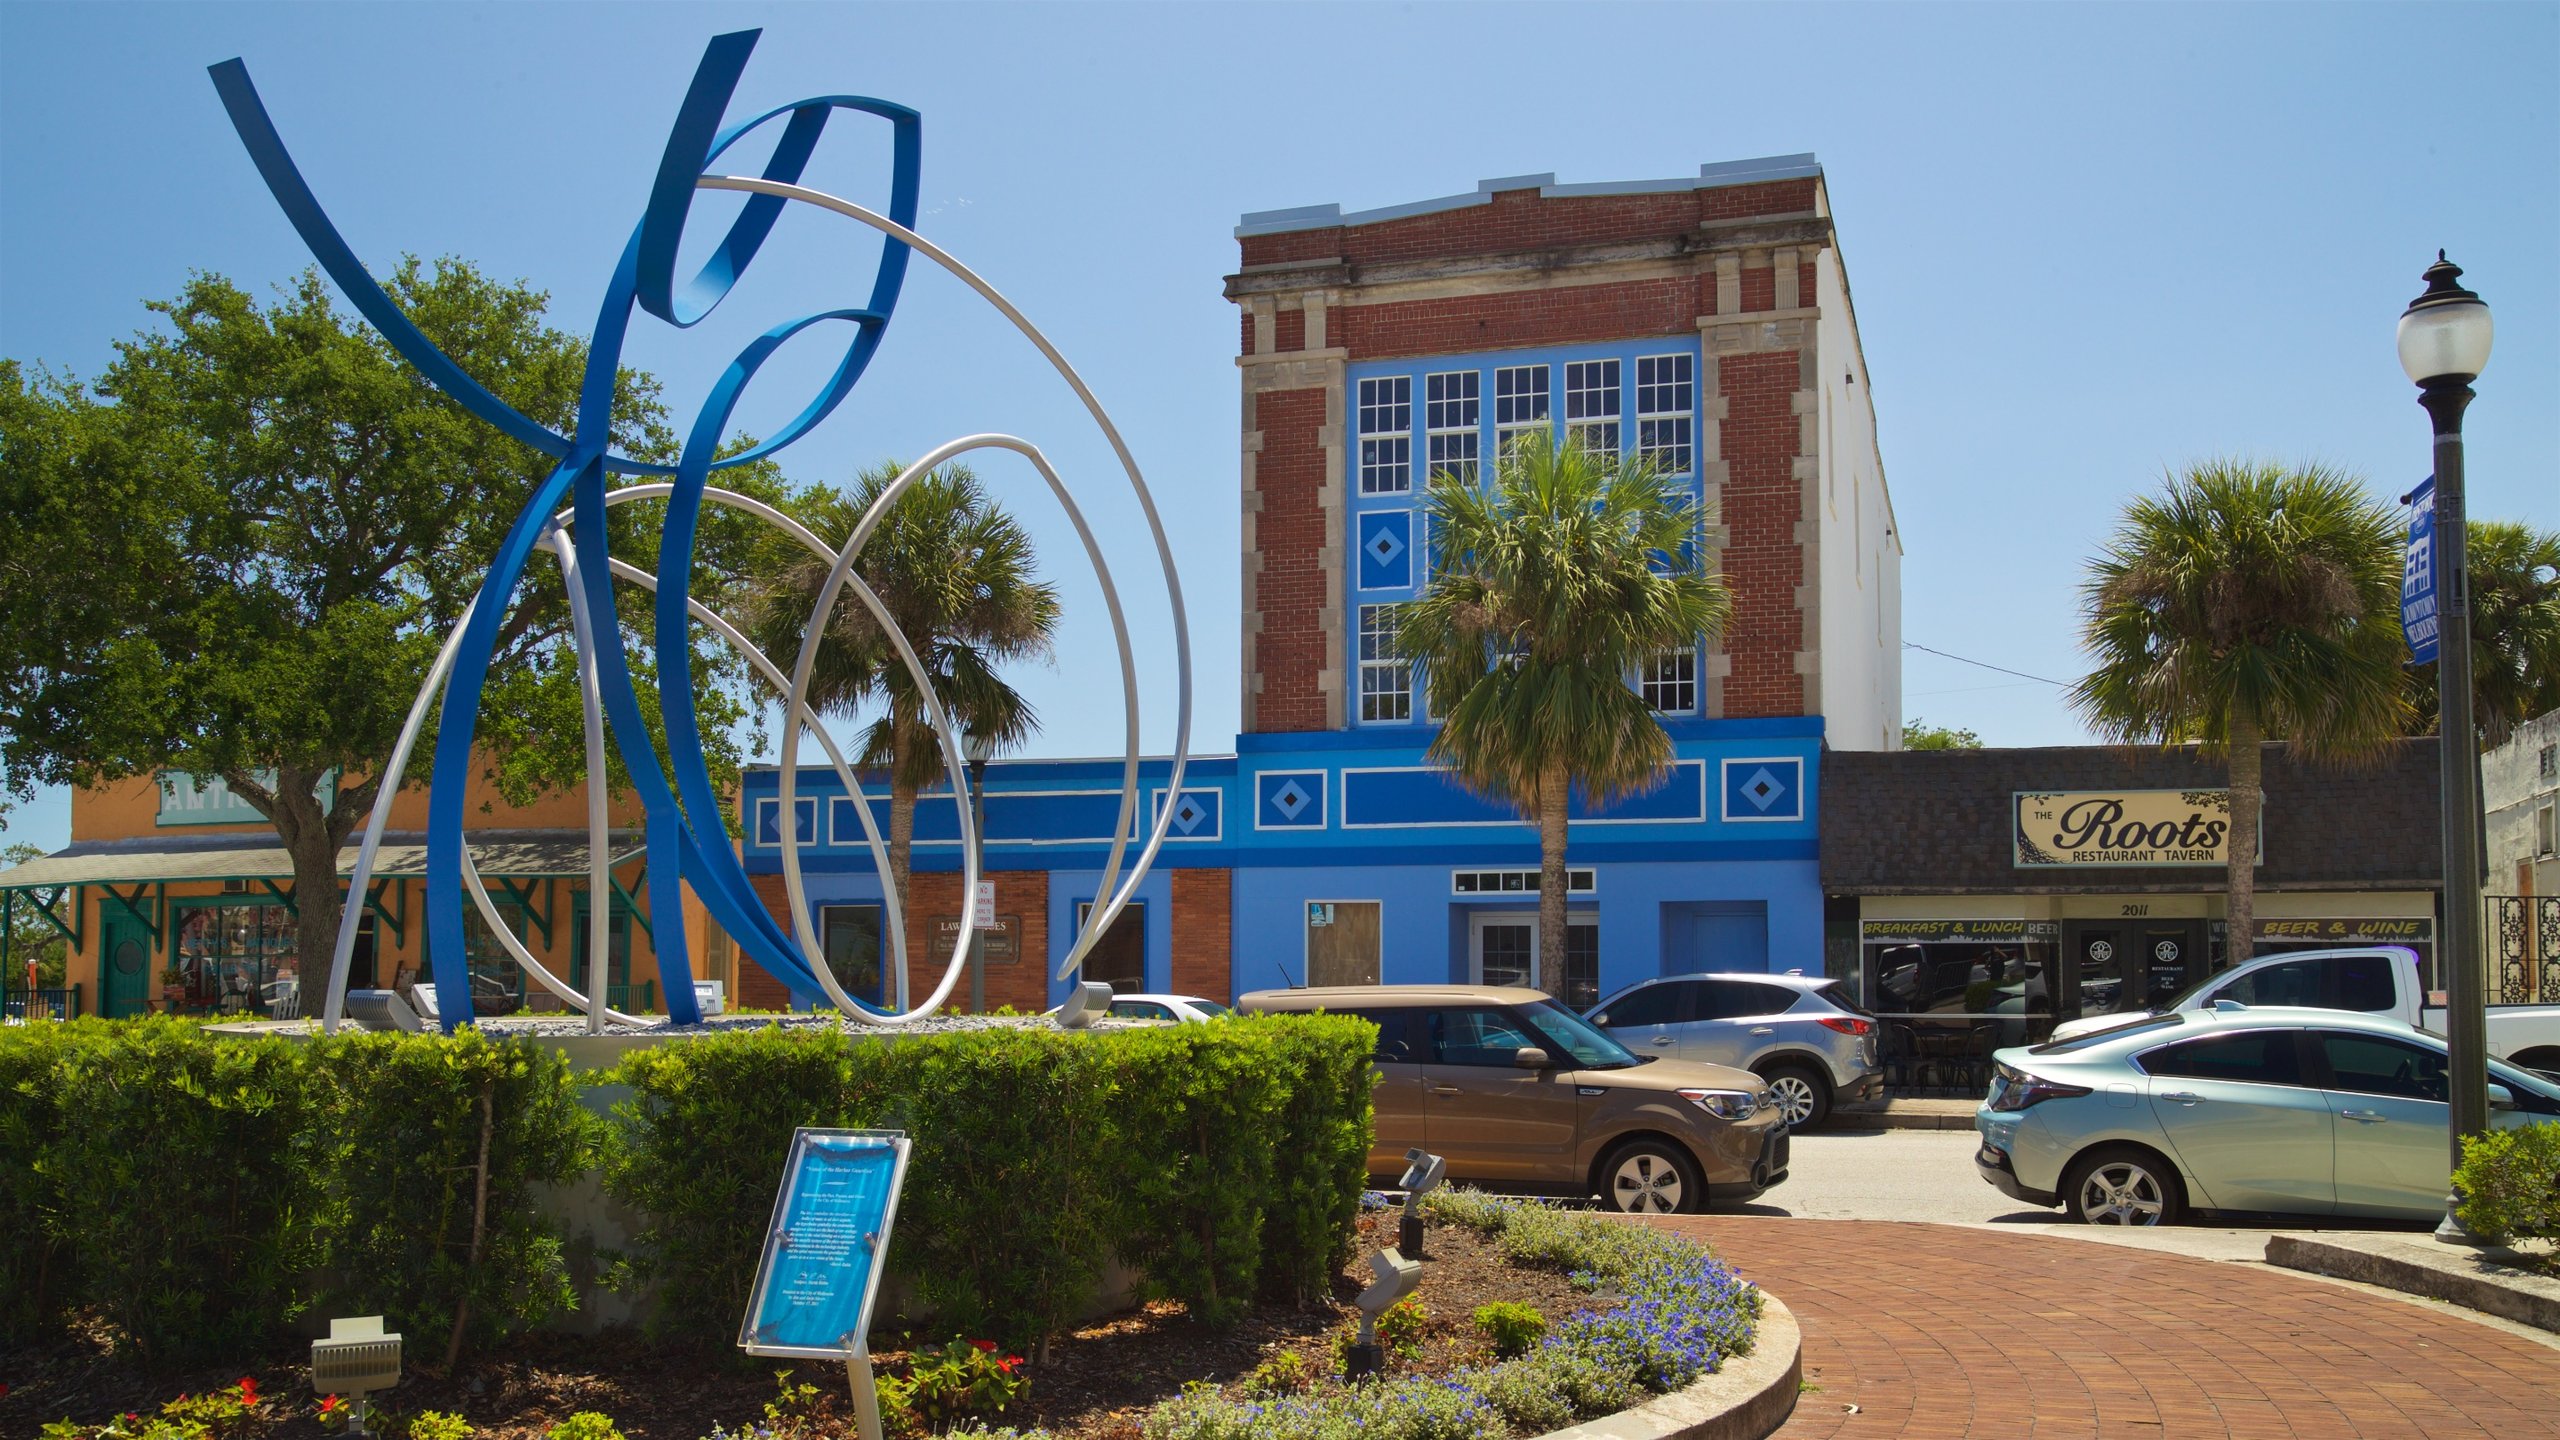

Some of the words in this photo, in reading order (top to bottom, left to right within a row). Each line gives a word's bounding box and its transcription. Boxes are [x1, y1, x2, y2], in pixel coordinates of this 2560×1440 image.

[2403, 594, 2436, 624] DOWNTOWN
[2034, 811, 2053, 820] THE
[2053, 799, 2227, 849] Roots
[2073, 850, 2156, 862] RESTAURANT
[2164, 850, 2215, 861] TAVERN
[2121, 904, 2149, 916] 2011
[941, 922, 960, 931] LAW
[1863, 922, 1950, 934] BREAKFAST
[1953, 922, 1965, 933] &
[1972, 922, 2024, 933] LUNCH
[2028, 923, 2059, 934] BEER
[2263, 922, 2319, 934] BEER
[2328, 922, 2347, 933] &
[2357, 922, 2420, 934] WINE
